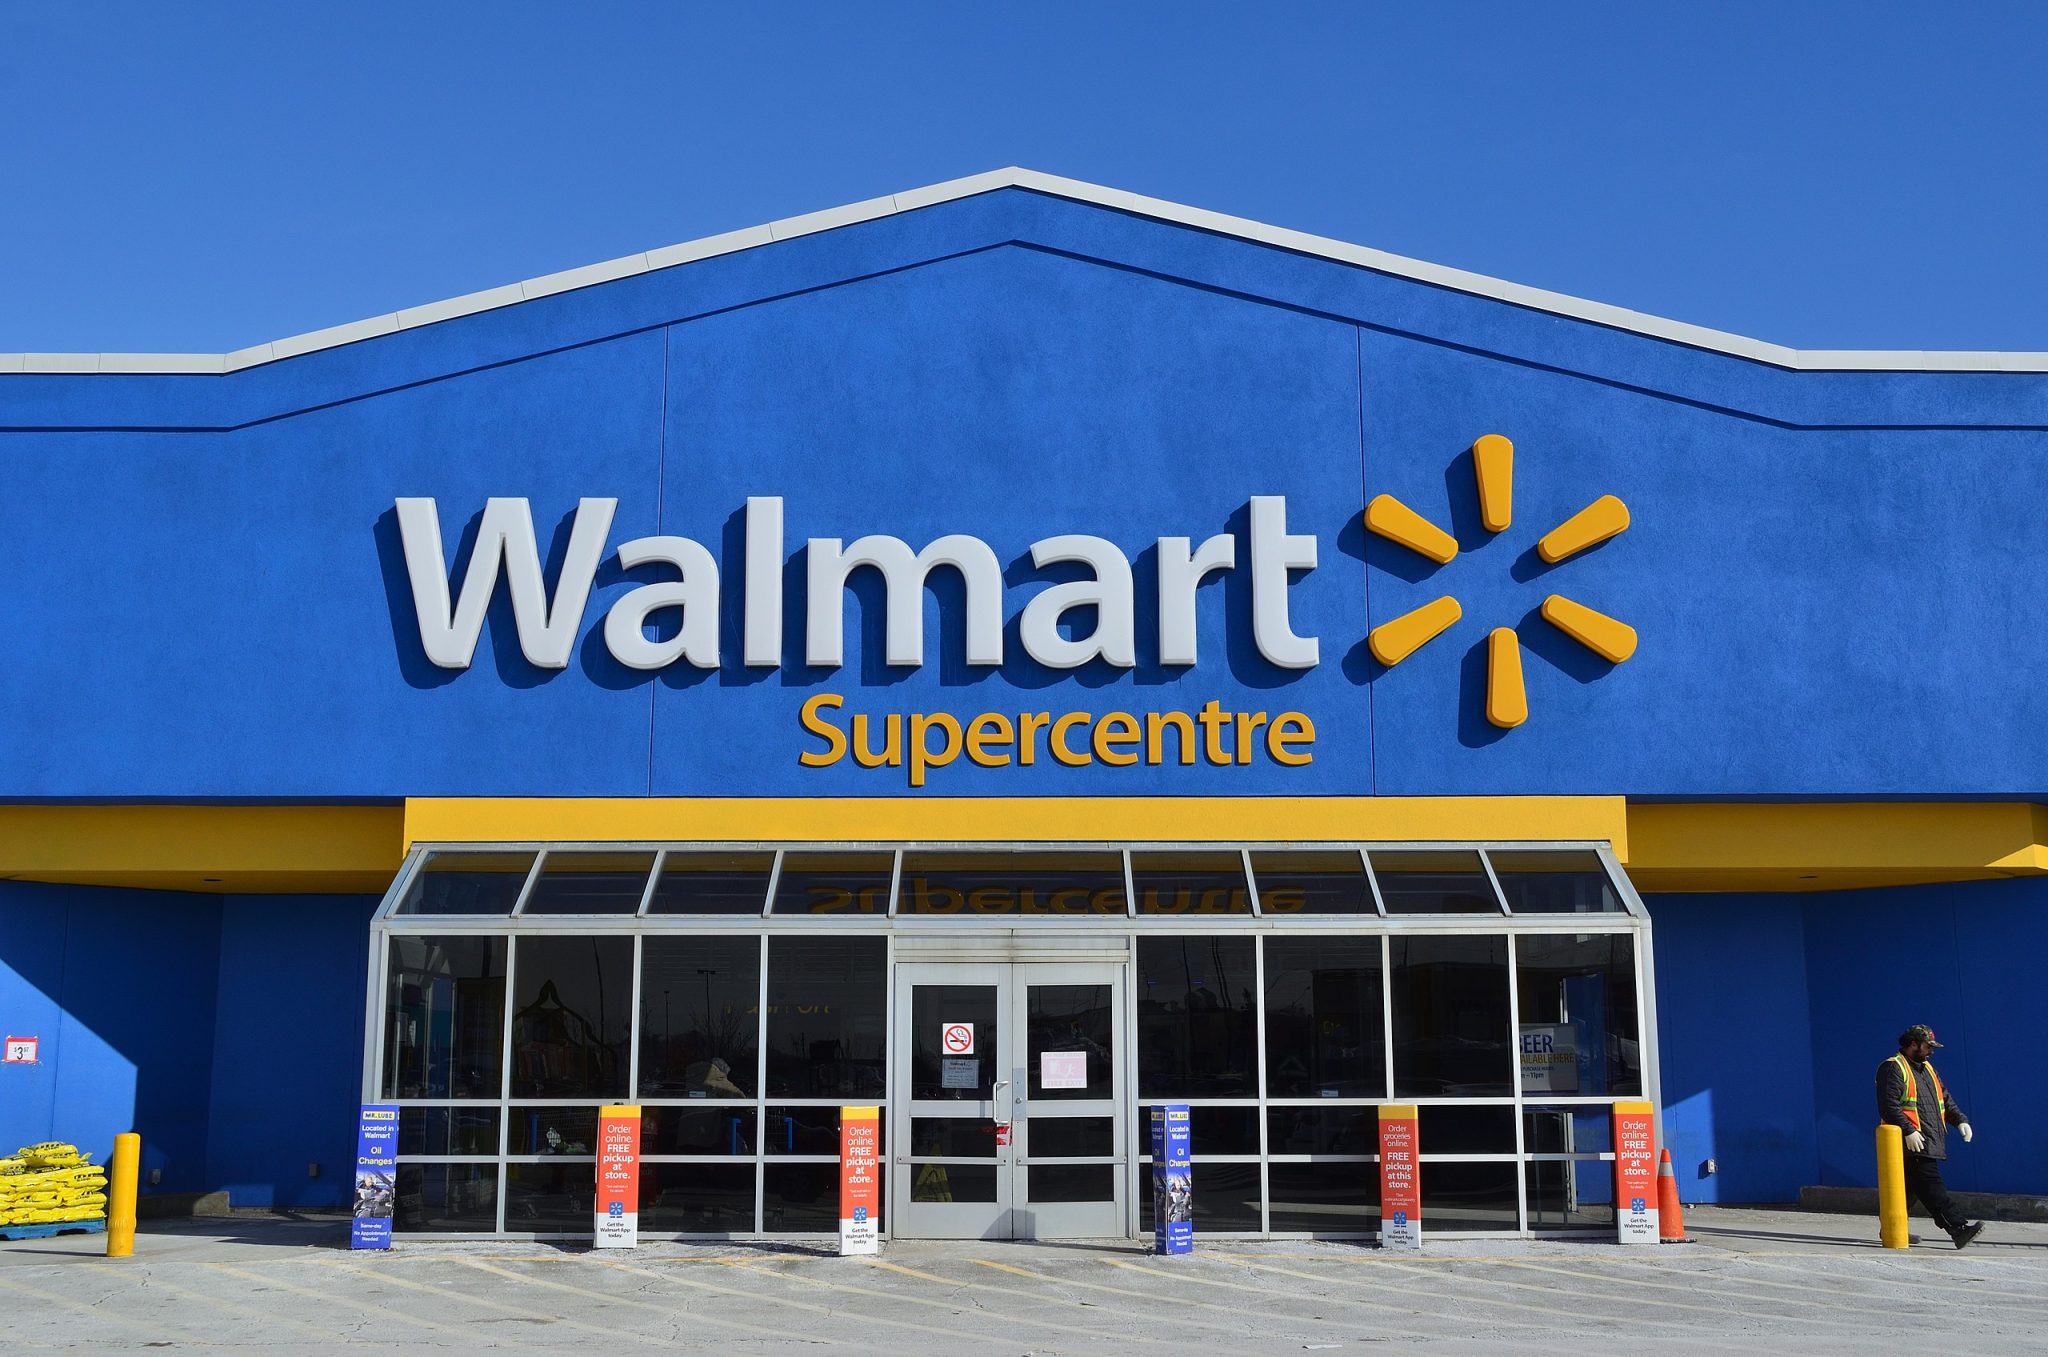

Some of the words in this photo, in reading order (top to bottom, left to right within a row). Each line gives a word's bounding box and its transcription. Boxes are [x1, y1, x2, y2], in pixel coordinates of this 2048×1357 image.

[395, 495, 1319, 671] Walmart
[798, 693, 1317, 787] Supercentre
[607, 1124, 632, 1133] Order
[1388, 1124, 1407, 1132] Order
[1622, 1120, 1647, 1130] Order
[849, 1126, 872, 1136] Order
[371, 1146, 382, 1154] Oil
[603, 1153, 634, 1164] pickup
[1621, 1150, 1652, 1160] pickup
[358, 1157, 393, 1166] Changes
[846, 1157, 875, 1168] pickup
[1631, 1159, 1641, 1167] at
[855, 1166, 865, 1174] at
[1385, 1162, 1412, 1172] pickup
[1624, 1167, 1650, 1176] store.
[605, 1170, 631, 1179] store.
[1396, 1172, 1412, 1180] this
[848, 1176, 874, 1184] store.
[1388, 1181, 1411, 1189] store.
